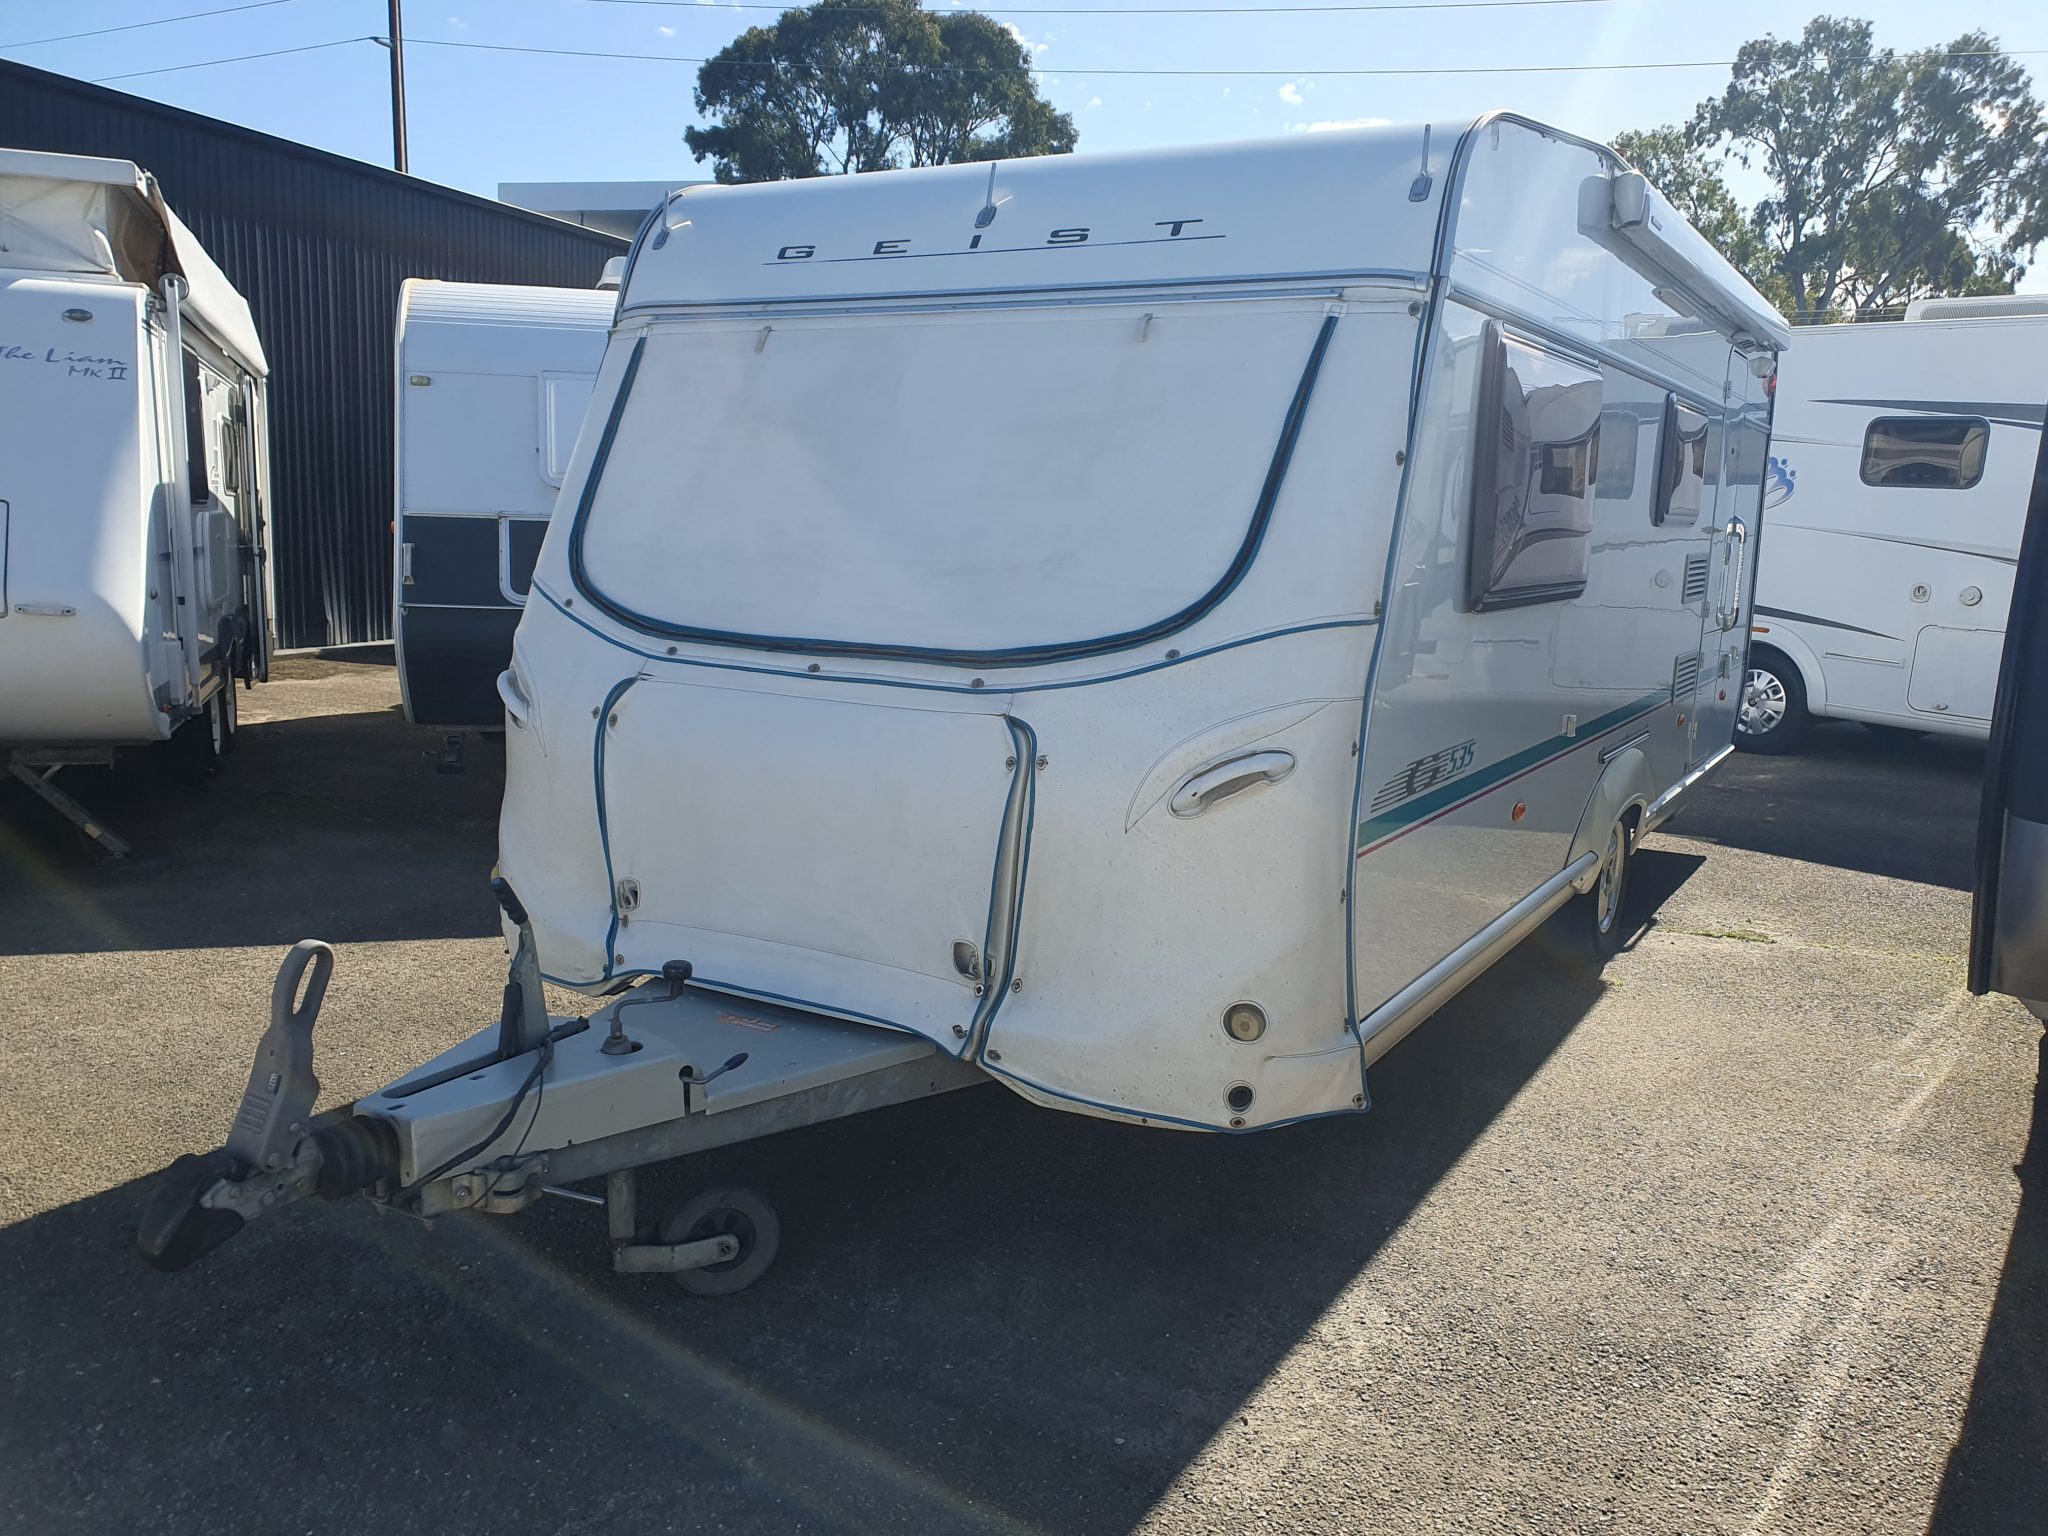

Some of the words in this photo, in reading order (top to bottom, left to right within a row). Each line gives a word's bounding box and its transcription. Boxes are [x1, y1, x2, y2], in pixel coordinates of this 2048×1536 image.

[777, 218, 1204, 261] GEIST
[45, 348, 127, 366] Liam
[1446, 741, 1477, 775] 535
